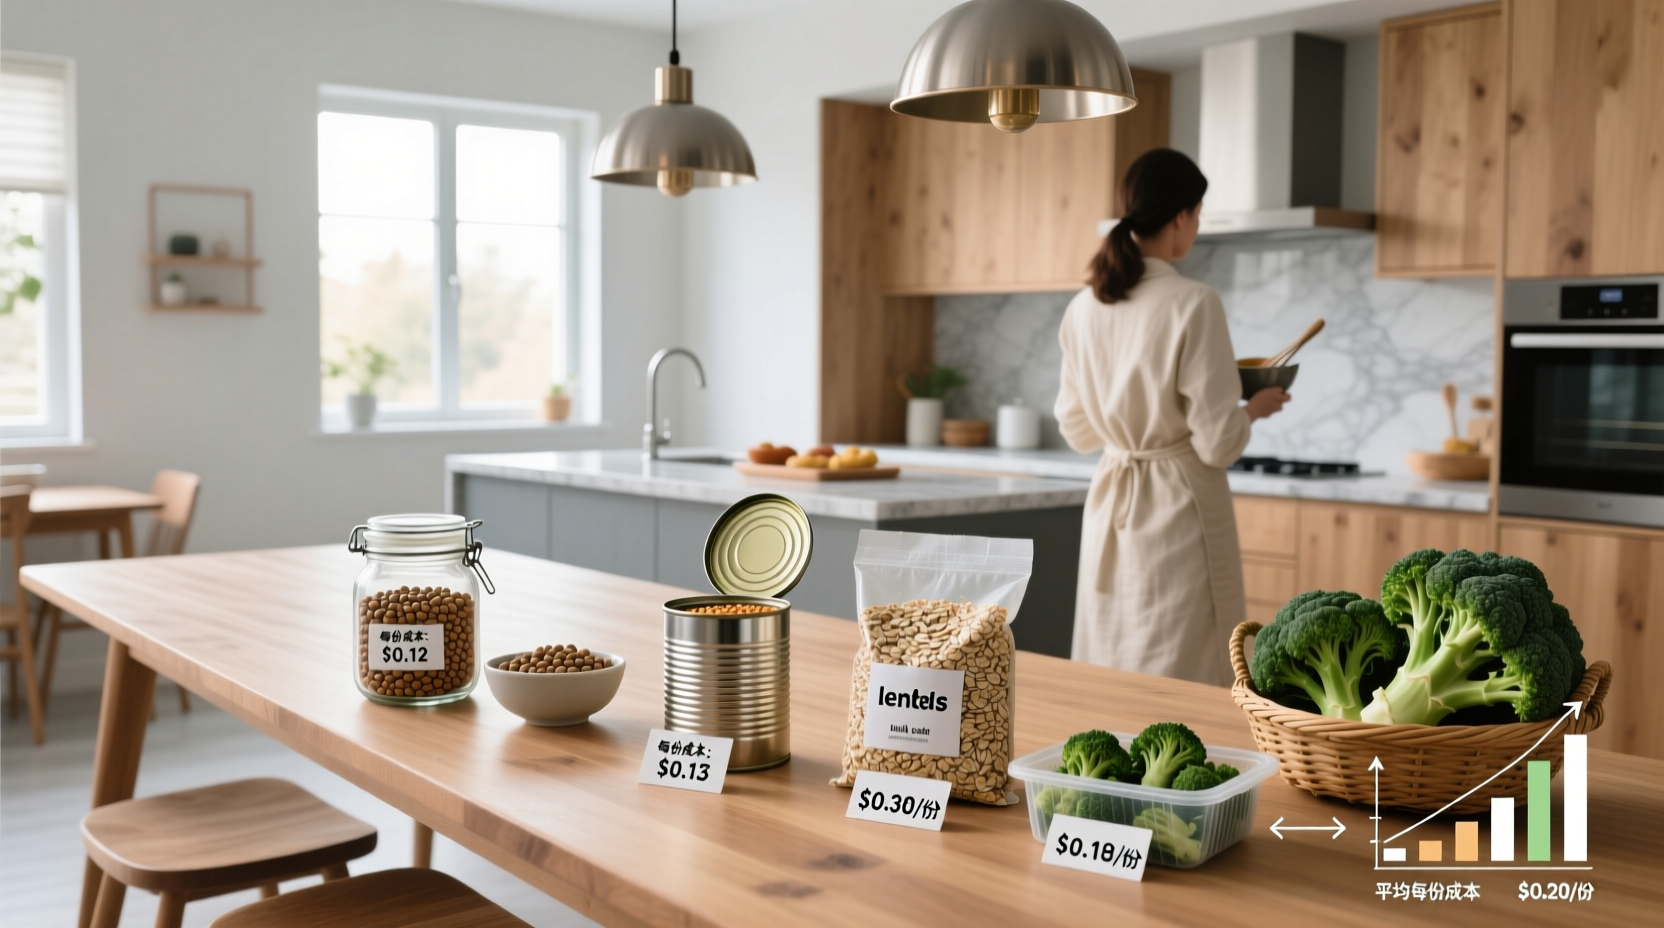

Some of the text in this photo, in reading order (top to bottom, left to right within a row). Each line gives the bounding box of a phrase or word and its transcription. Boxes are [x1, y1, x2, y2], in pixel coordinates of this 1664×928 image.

[382, 646, 428, 663] $0.12
[657, 757, 711, 781] $0.13
[858, 787, 941, 820] $0.30/份
